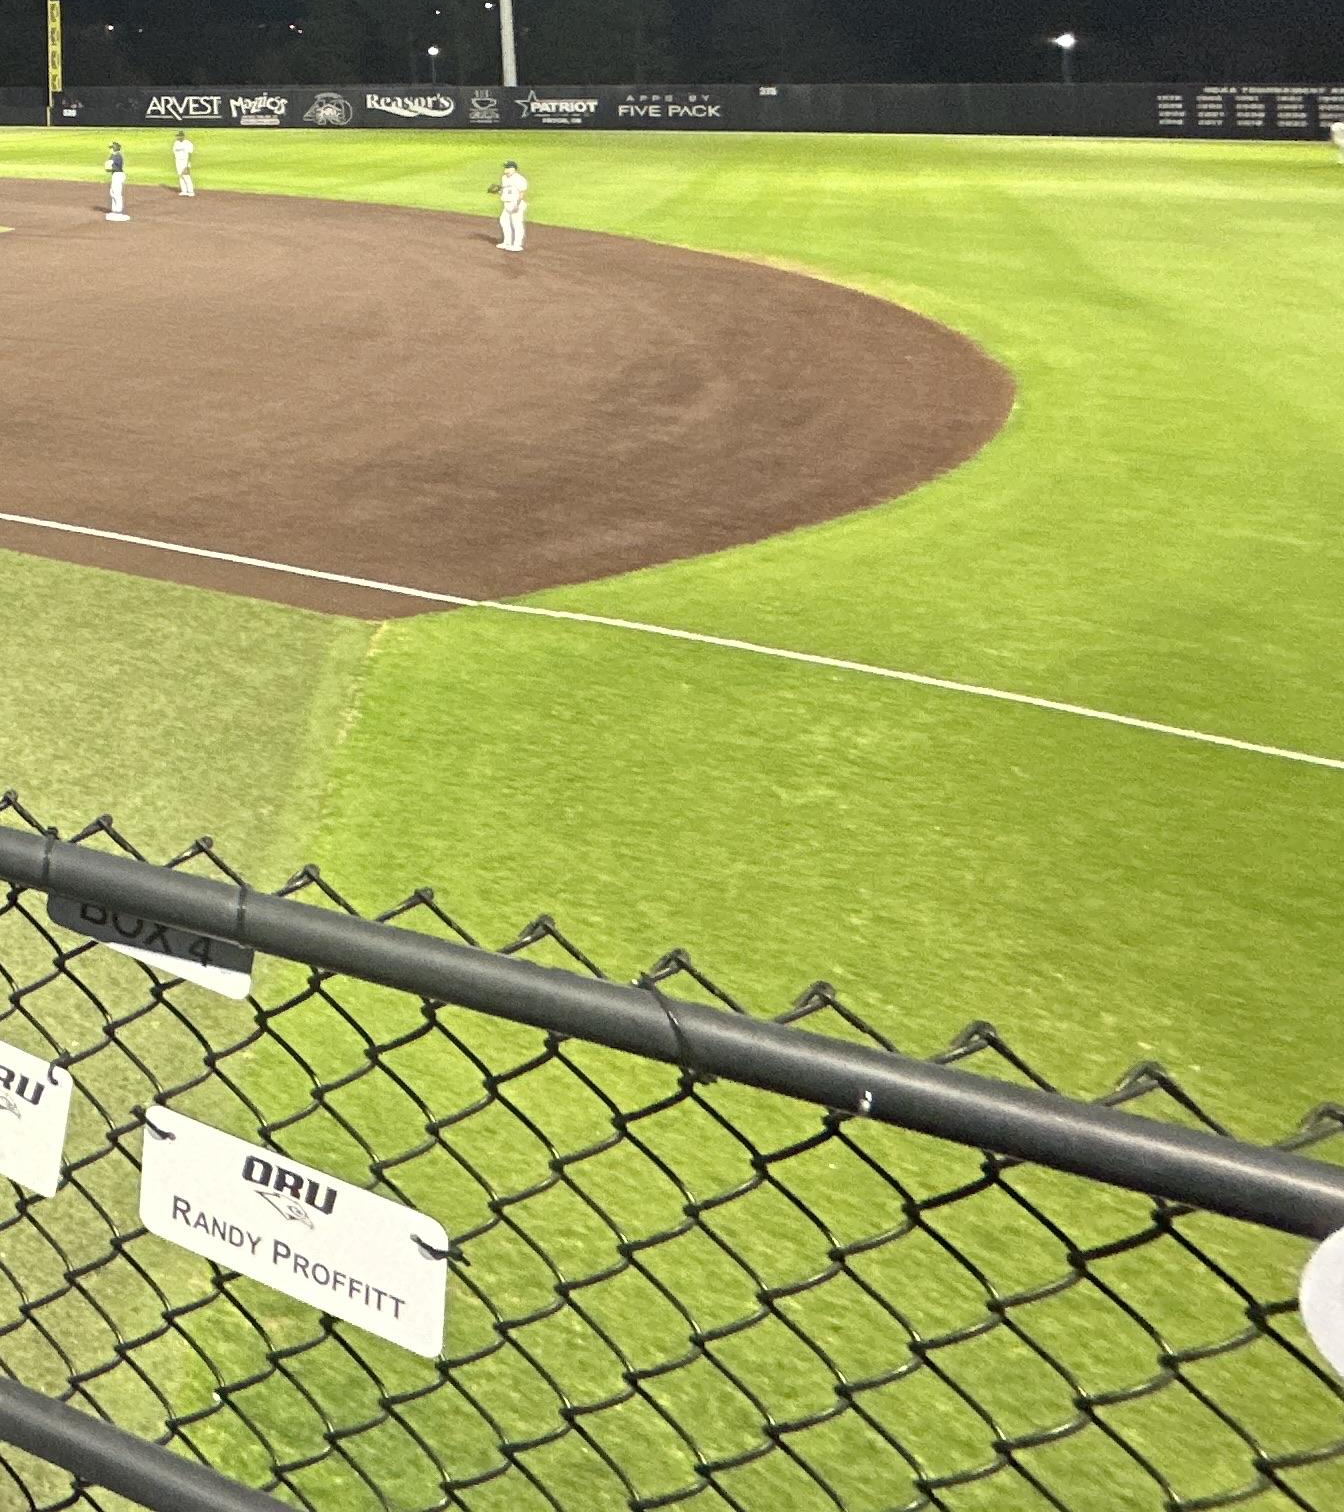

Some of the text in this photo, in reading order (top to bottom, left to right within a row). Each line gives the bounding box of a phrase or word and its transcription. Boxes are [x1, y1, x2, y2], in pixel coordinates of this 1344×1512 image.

[146, 96, 221, 119] ARVEST
[229, 92, 288, 118] Mazzio's
[366, 93, 454, 117] Reasor's
[530, 100, 598, 113] PATRIOT
[618, 104, 721, 117] FIVE PACK
[187, 936, 212, 967] 4
[241, 1154, 338, 1215] ORU
[172, 1195, 406, 1320] RANDY PROFFITT
